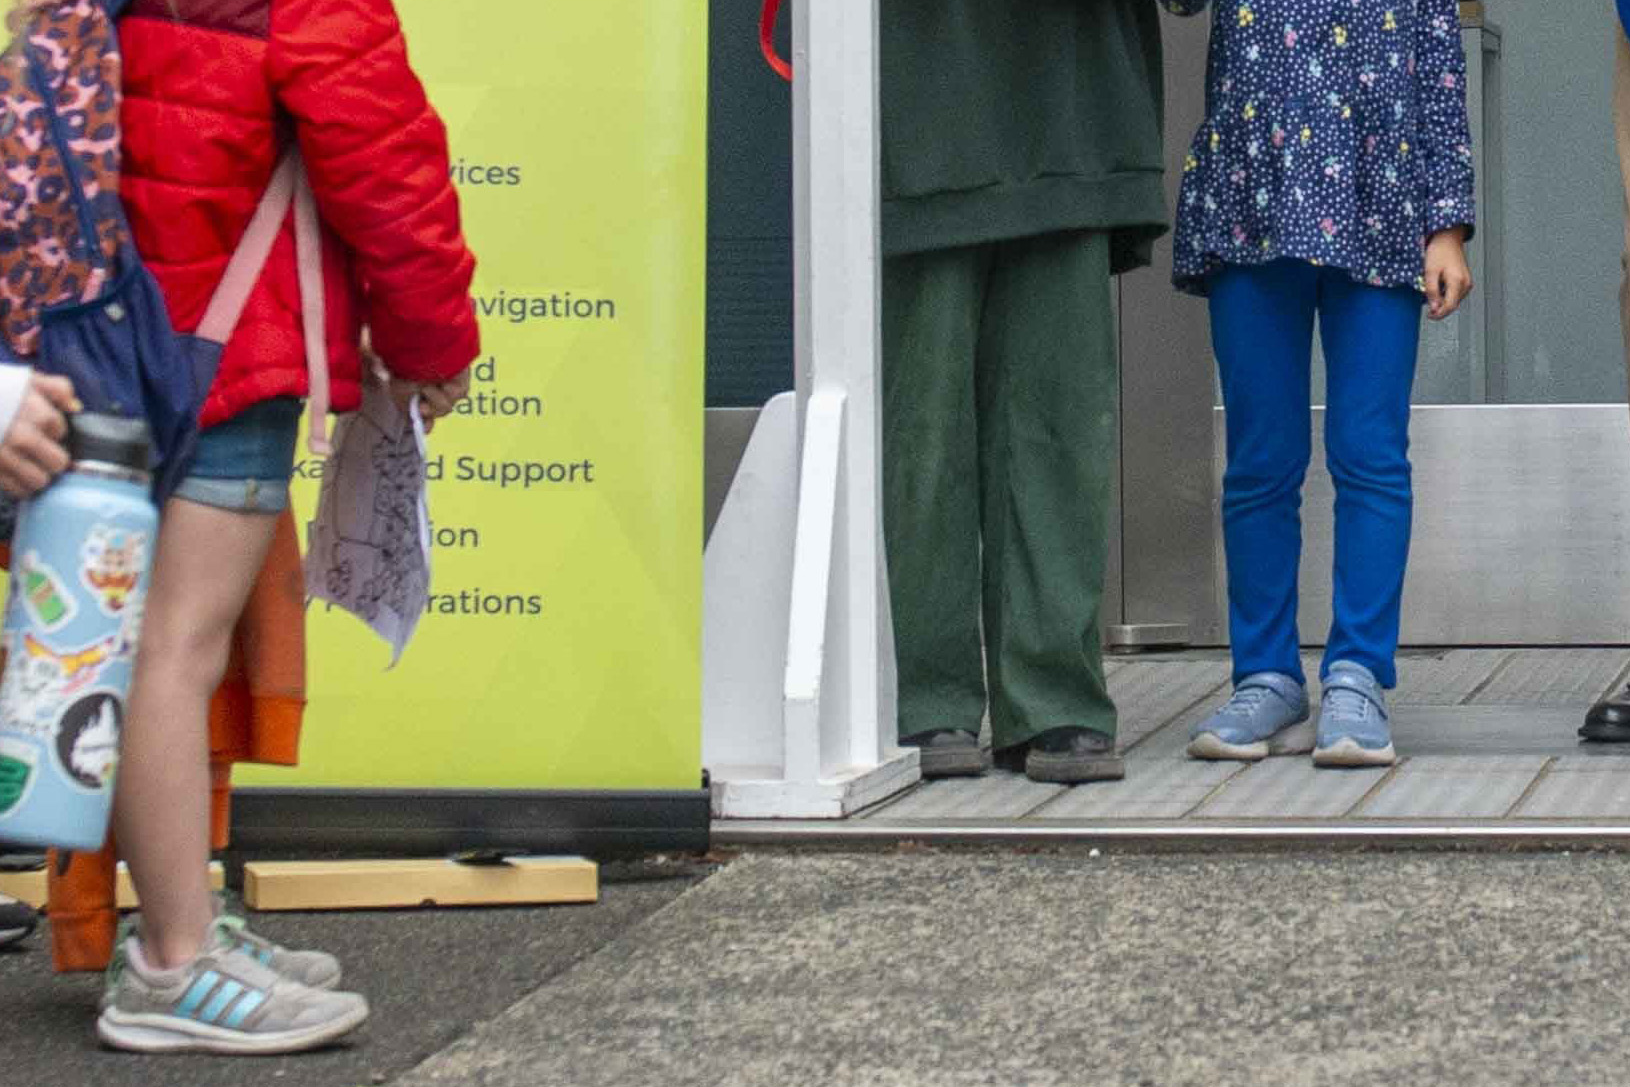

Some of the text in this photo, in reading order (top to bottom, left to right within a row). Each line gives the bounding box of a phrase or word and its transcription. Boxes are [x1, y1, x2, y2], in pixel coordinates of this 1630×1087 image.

[447, 161, 521, 186] vices
[472, 290, 616, 324] vigation
[455, 455, 595, 488] Support
[427, 587, 542, 615] rations
